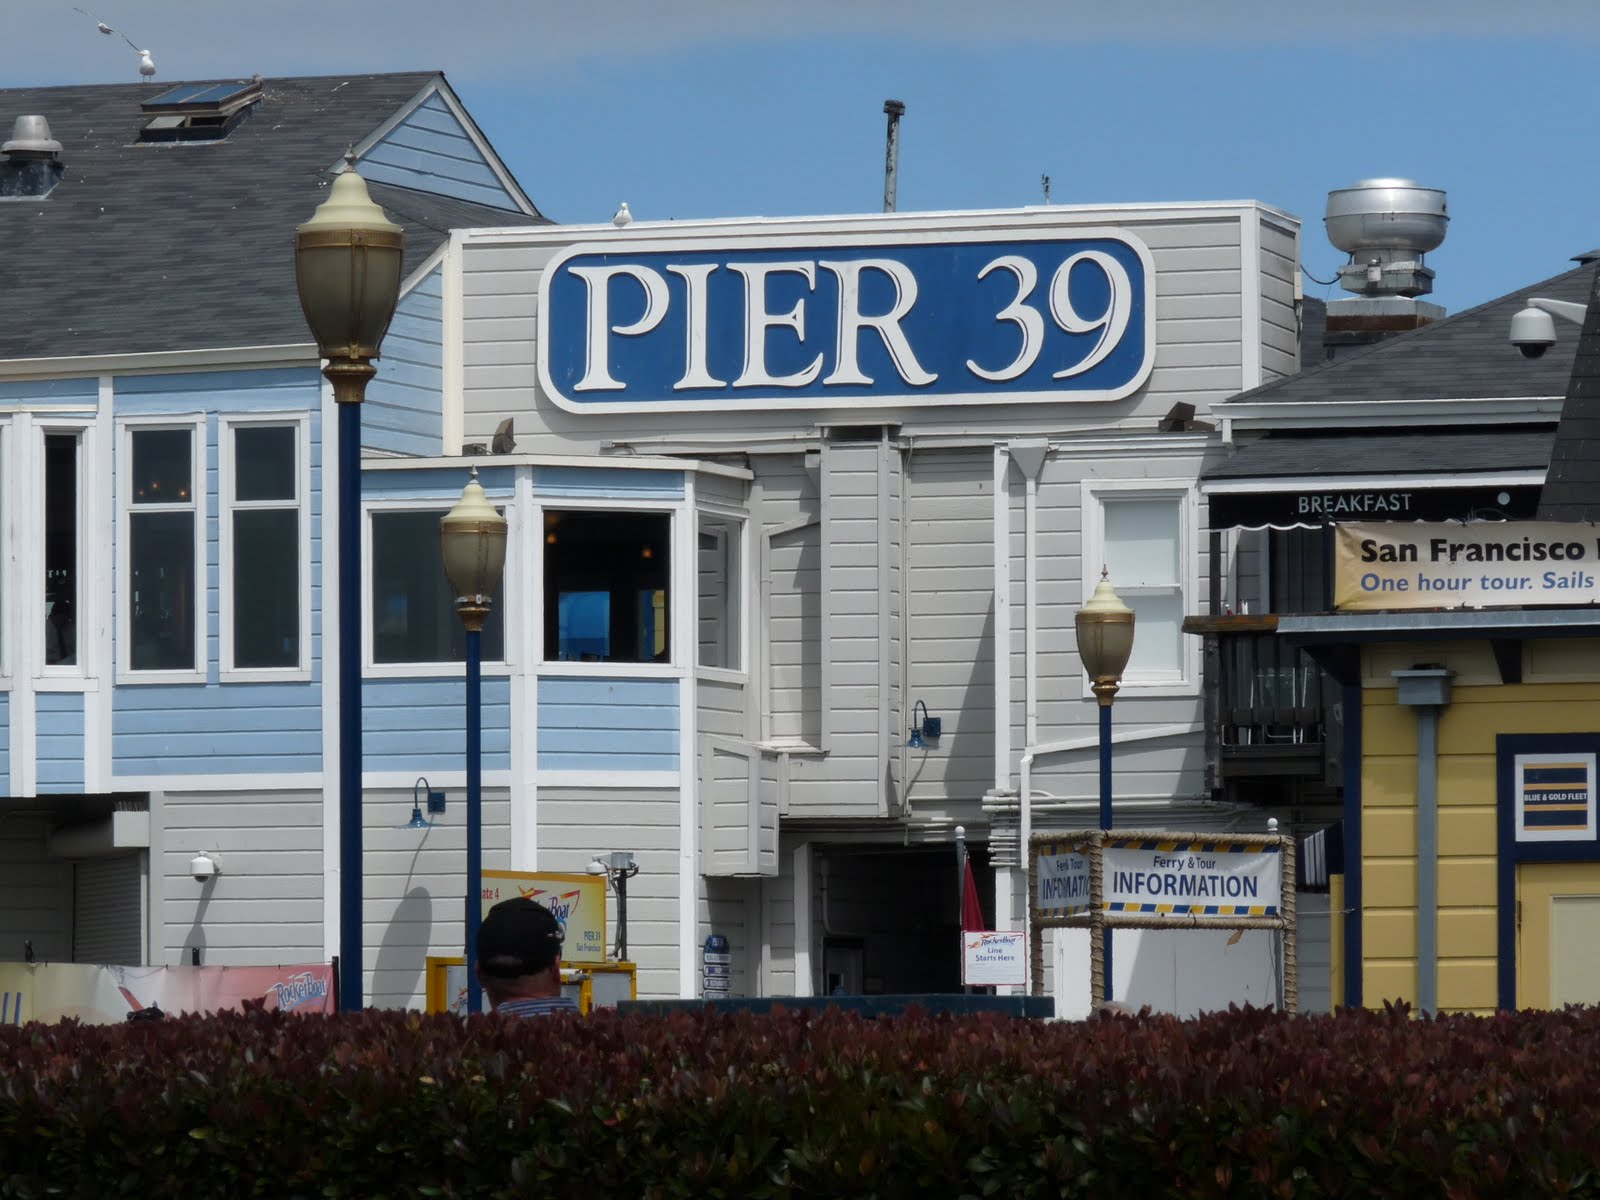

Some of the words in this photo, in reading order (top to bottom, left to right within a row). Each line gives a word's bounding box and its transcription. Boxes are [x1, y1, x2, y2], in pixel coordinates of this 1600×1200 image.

[569, 257, 938, 391] PIER
[966, 250, 1132, 382] 39
[1299, 491, 1412, 513] BREAKFAST
[1361, 539, 1418, 562] San
[1430, 537, 1585, 562] Francisco
[1361, 573, 1409, 591] One
[1418, 573, 1472, 591] hour
[1481, 574, 1533, 590] tour.
[1542, 571, 1594, 589] Sails
[1524, 793, 1541, 801] BLUE
[1542, 793, 1547, 801] &
[1549, 793, 1566, 801] GOLD
[1568, 792, 1588, 800] FLEET
[1153, 856, 1185, 871] Ferry
[1188, 857, 1196, 869] &
[1197, 858, 1216, 869] Tour
[481, 889, 494, 900] ate
[1113, 871, 1258, 898] INFORMATION
[975, 954, 996, 962] Starts
